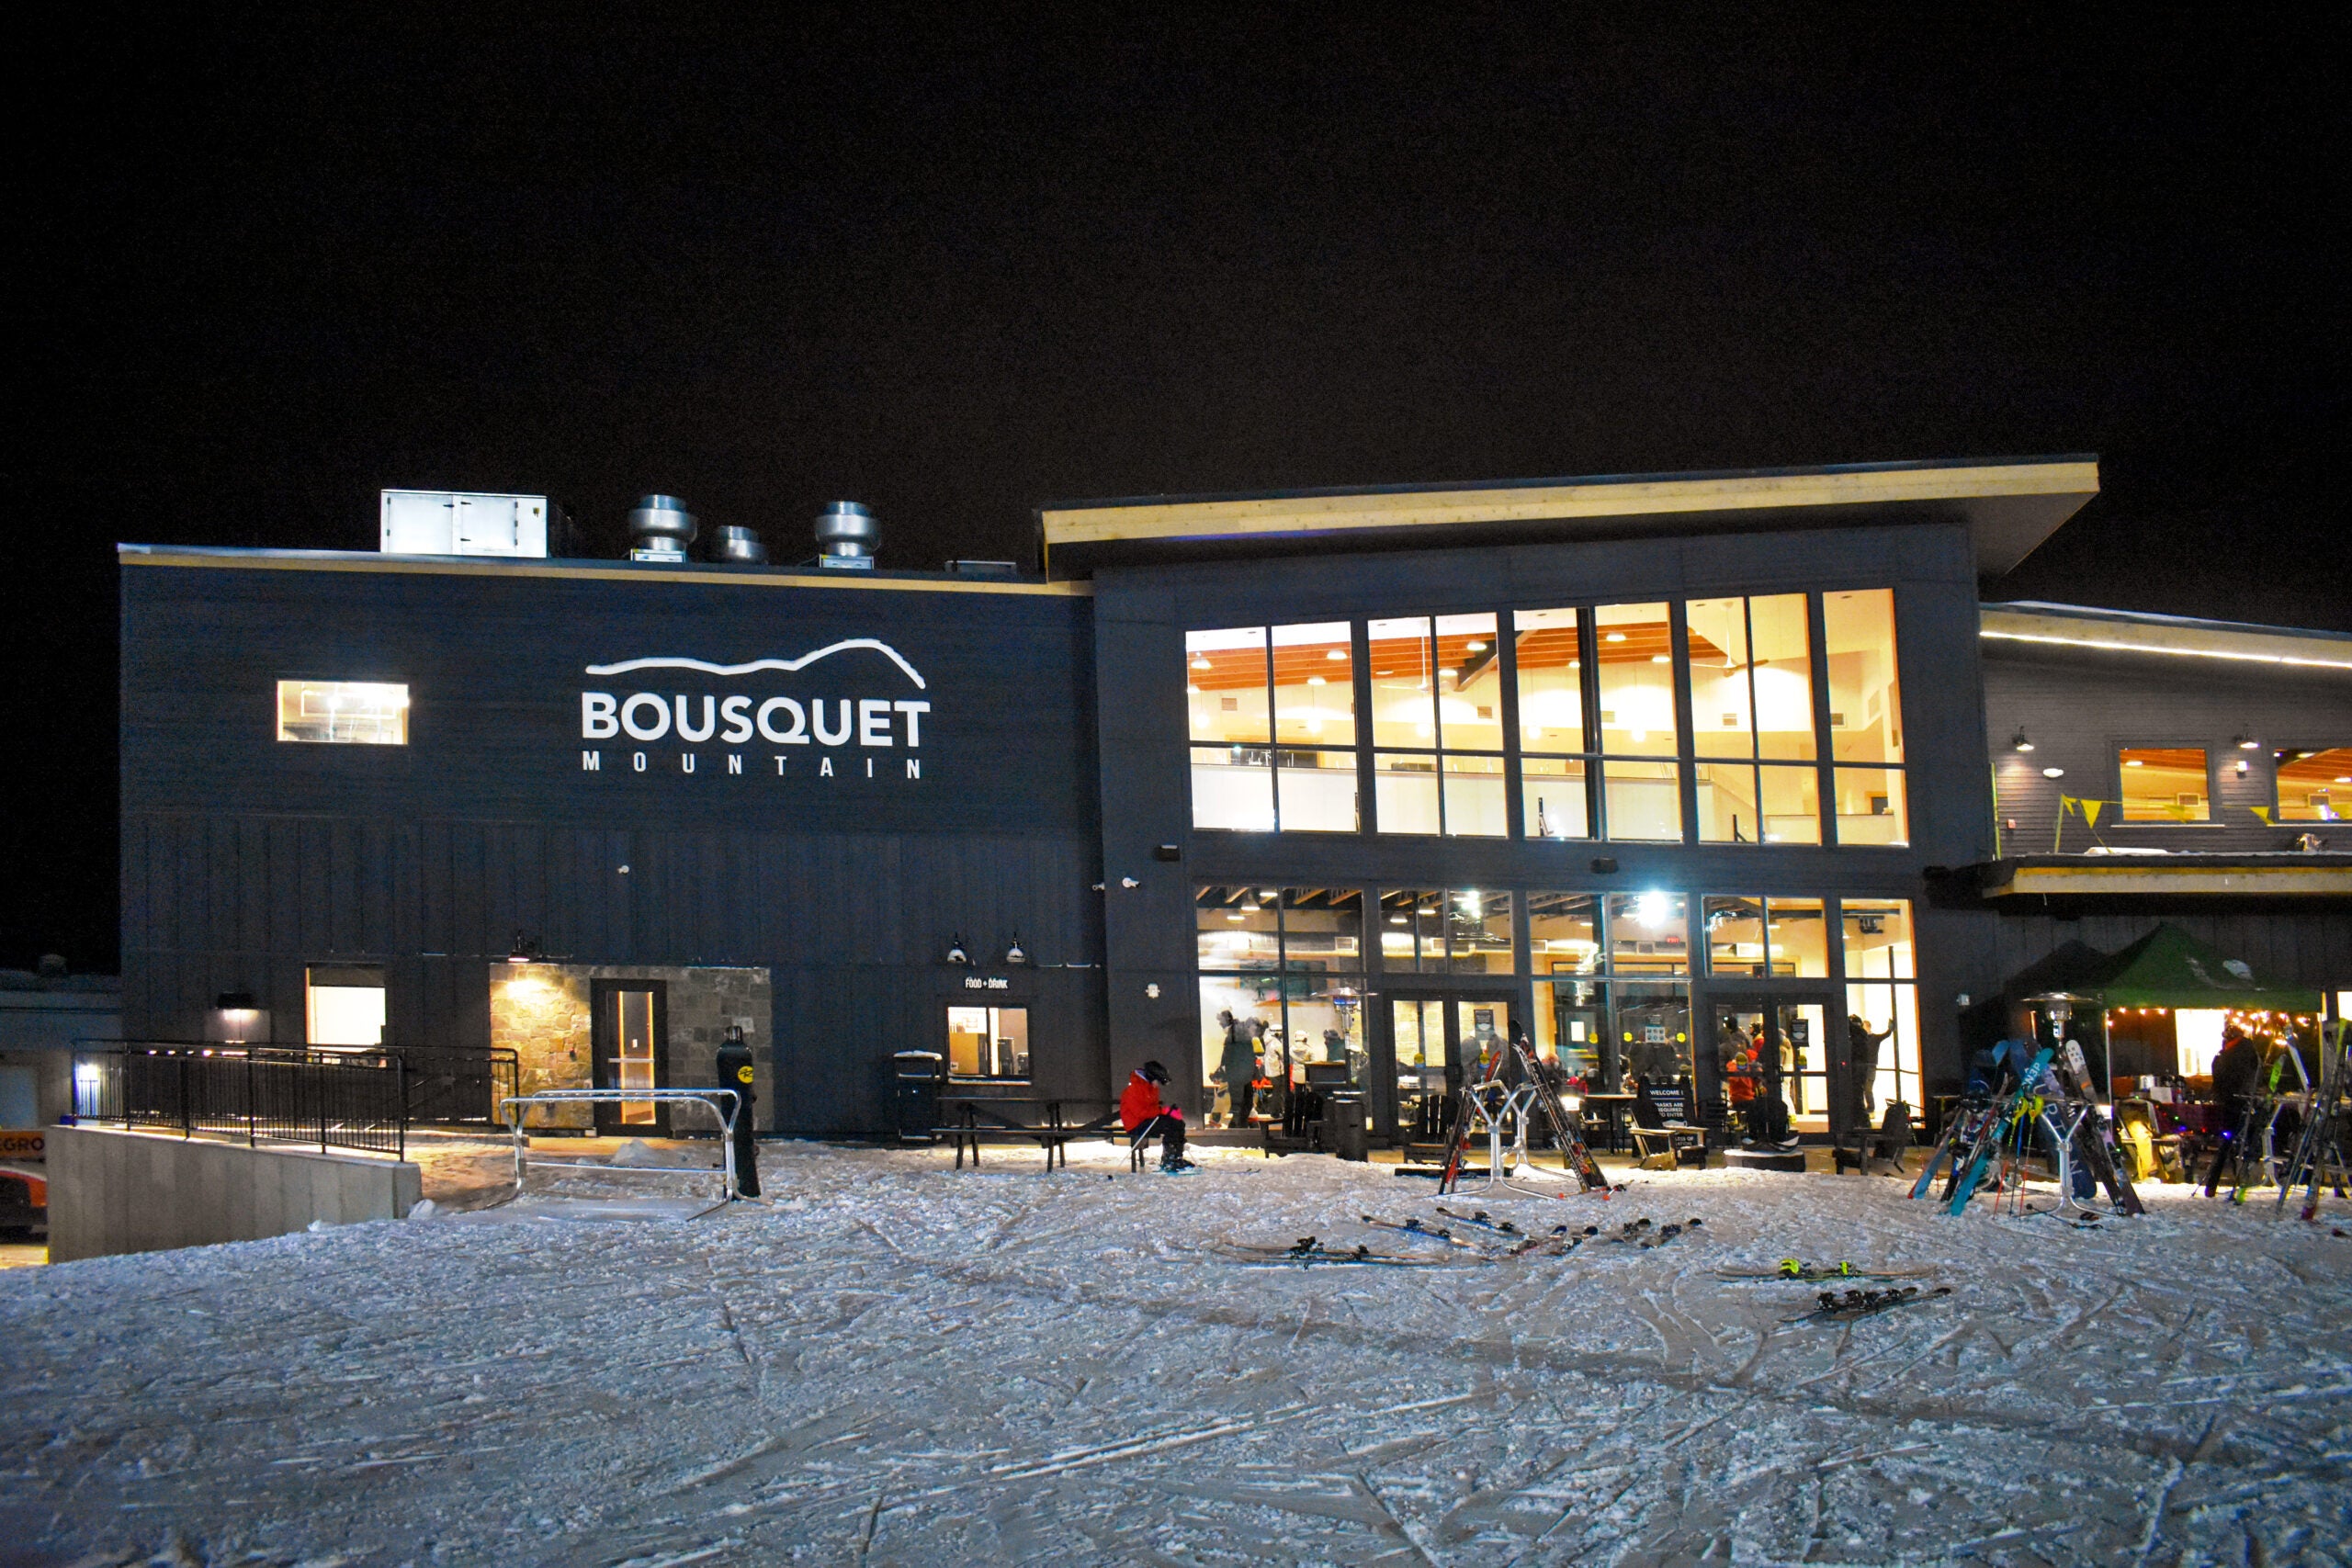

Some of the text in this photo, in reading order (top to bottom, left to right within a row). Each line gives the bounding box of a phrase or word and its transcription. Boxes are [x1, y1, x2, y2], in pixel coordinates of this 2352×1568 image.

[582, 692, 931, 748] BOUSQUET
[582, 751, 921, 780] MOUNTAIN
[965, 976, 982, 988] FOOD
[988, 976, 1008, 989] DRINK
[0, 1137, 45, 1151] GRO
